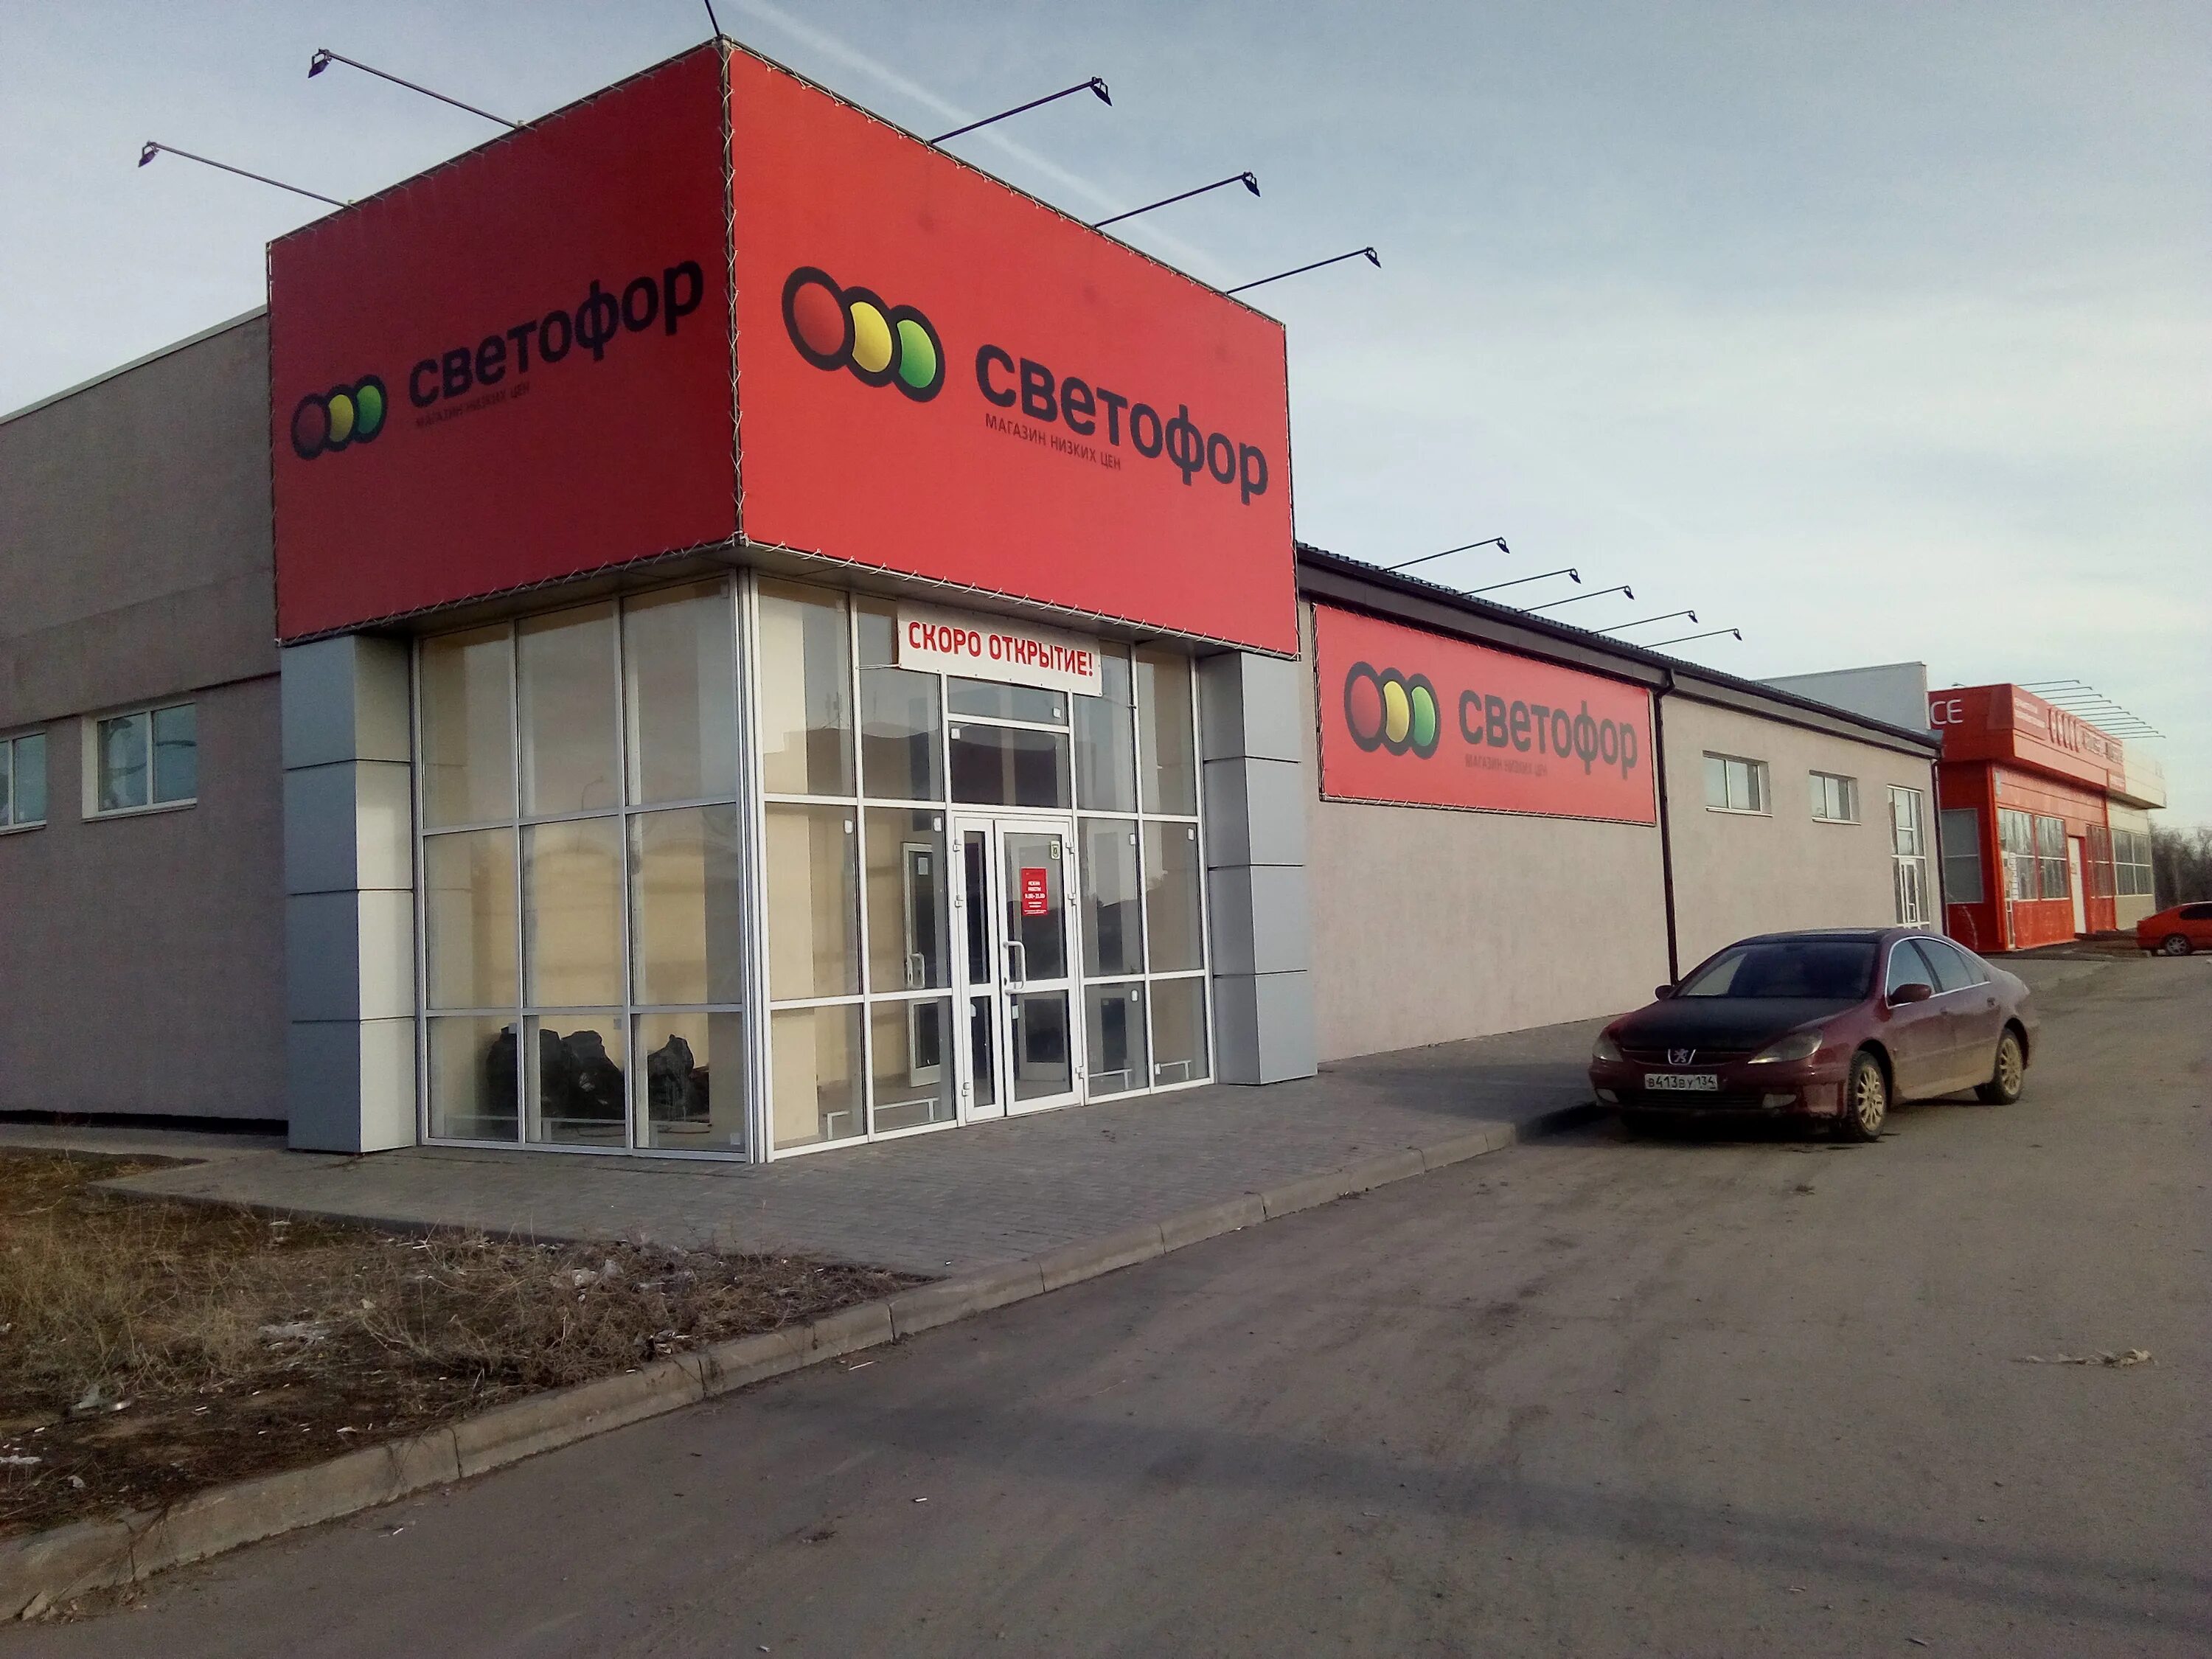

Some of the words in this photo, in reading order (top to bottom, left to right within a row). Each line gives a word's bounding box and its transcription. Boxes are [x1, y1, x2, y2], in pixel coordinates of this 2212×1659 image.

[409, 260, 703, 408] светофор
[975, 344, 1268, 505] светофор
[985, 413, 1046, 446] МАГАЗИН
[1050, 434, 1097, 463] НИЗКИХ
[1100, 451, 1121, 471] ЦЕН
[908, 621, 981, 658] СКОРО
[989, 634, 1093, 677] ОТКРЫТИЕ!
[1458, 689, 1638, 780] светофор
